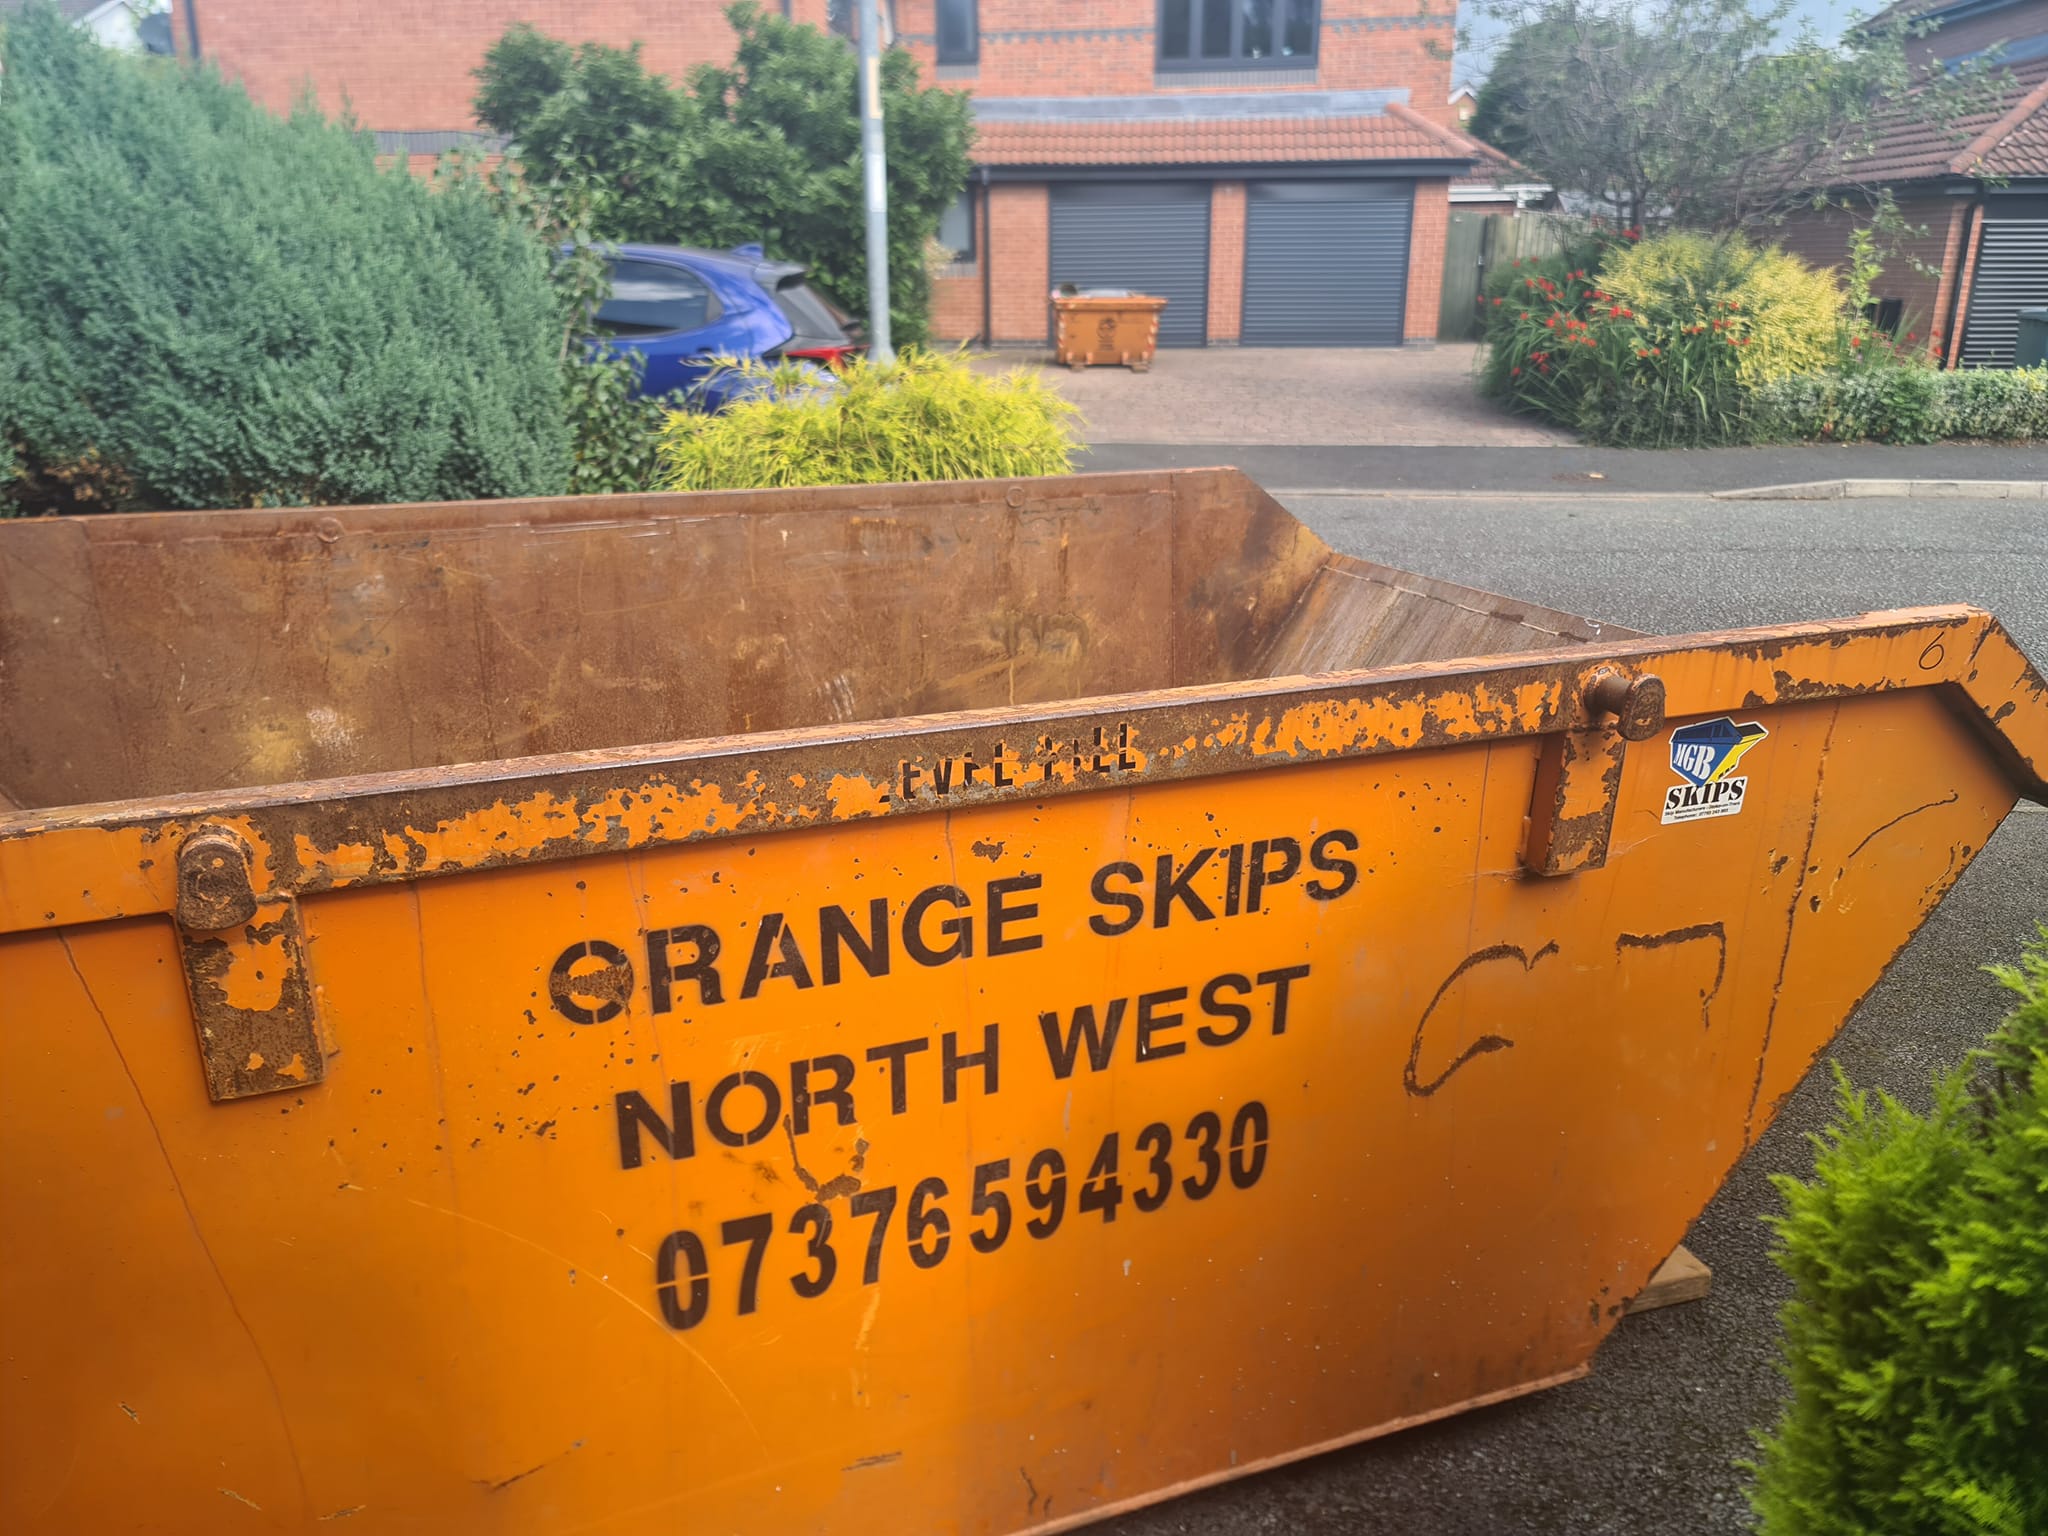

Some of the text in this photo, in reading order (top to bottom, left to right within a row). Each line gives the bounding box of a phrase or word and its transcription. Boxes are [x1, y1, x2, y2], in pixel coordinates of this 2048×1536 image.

[1665, 779, 1745, 809] SKIPS
[549, 829, 1359, 1025] ORANGE SKIPS
[615, 1023, 1000, 1169] NORTH
[1038, 964, 1310, 1079] WEST
[655, 1100, 1270, 1331] 07376594330
